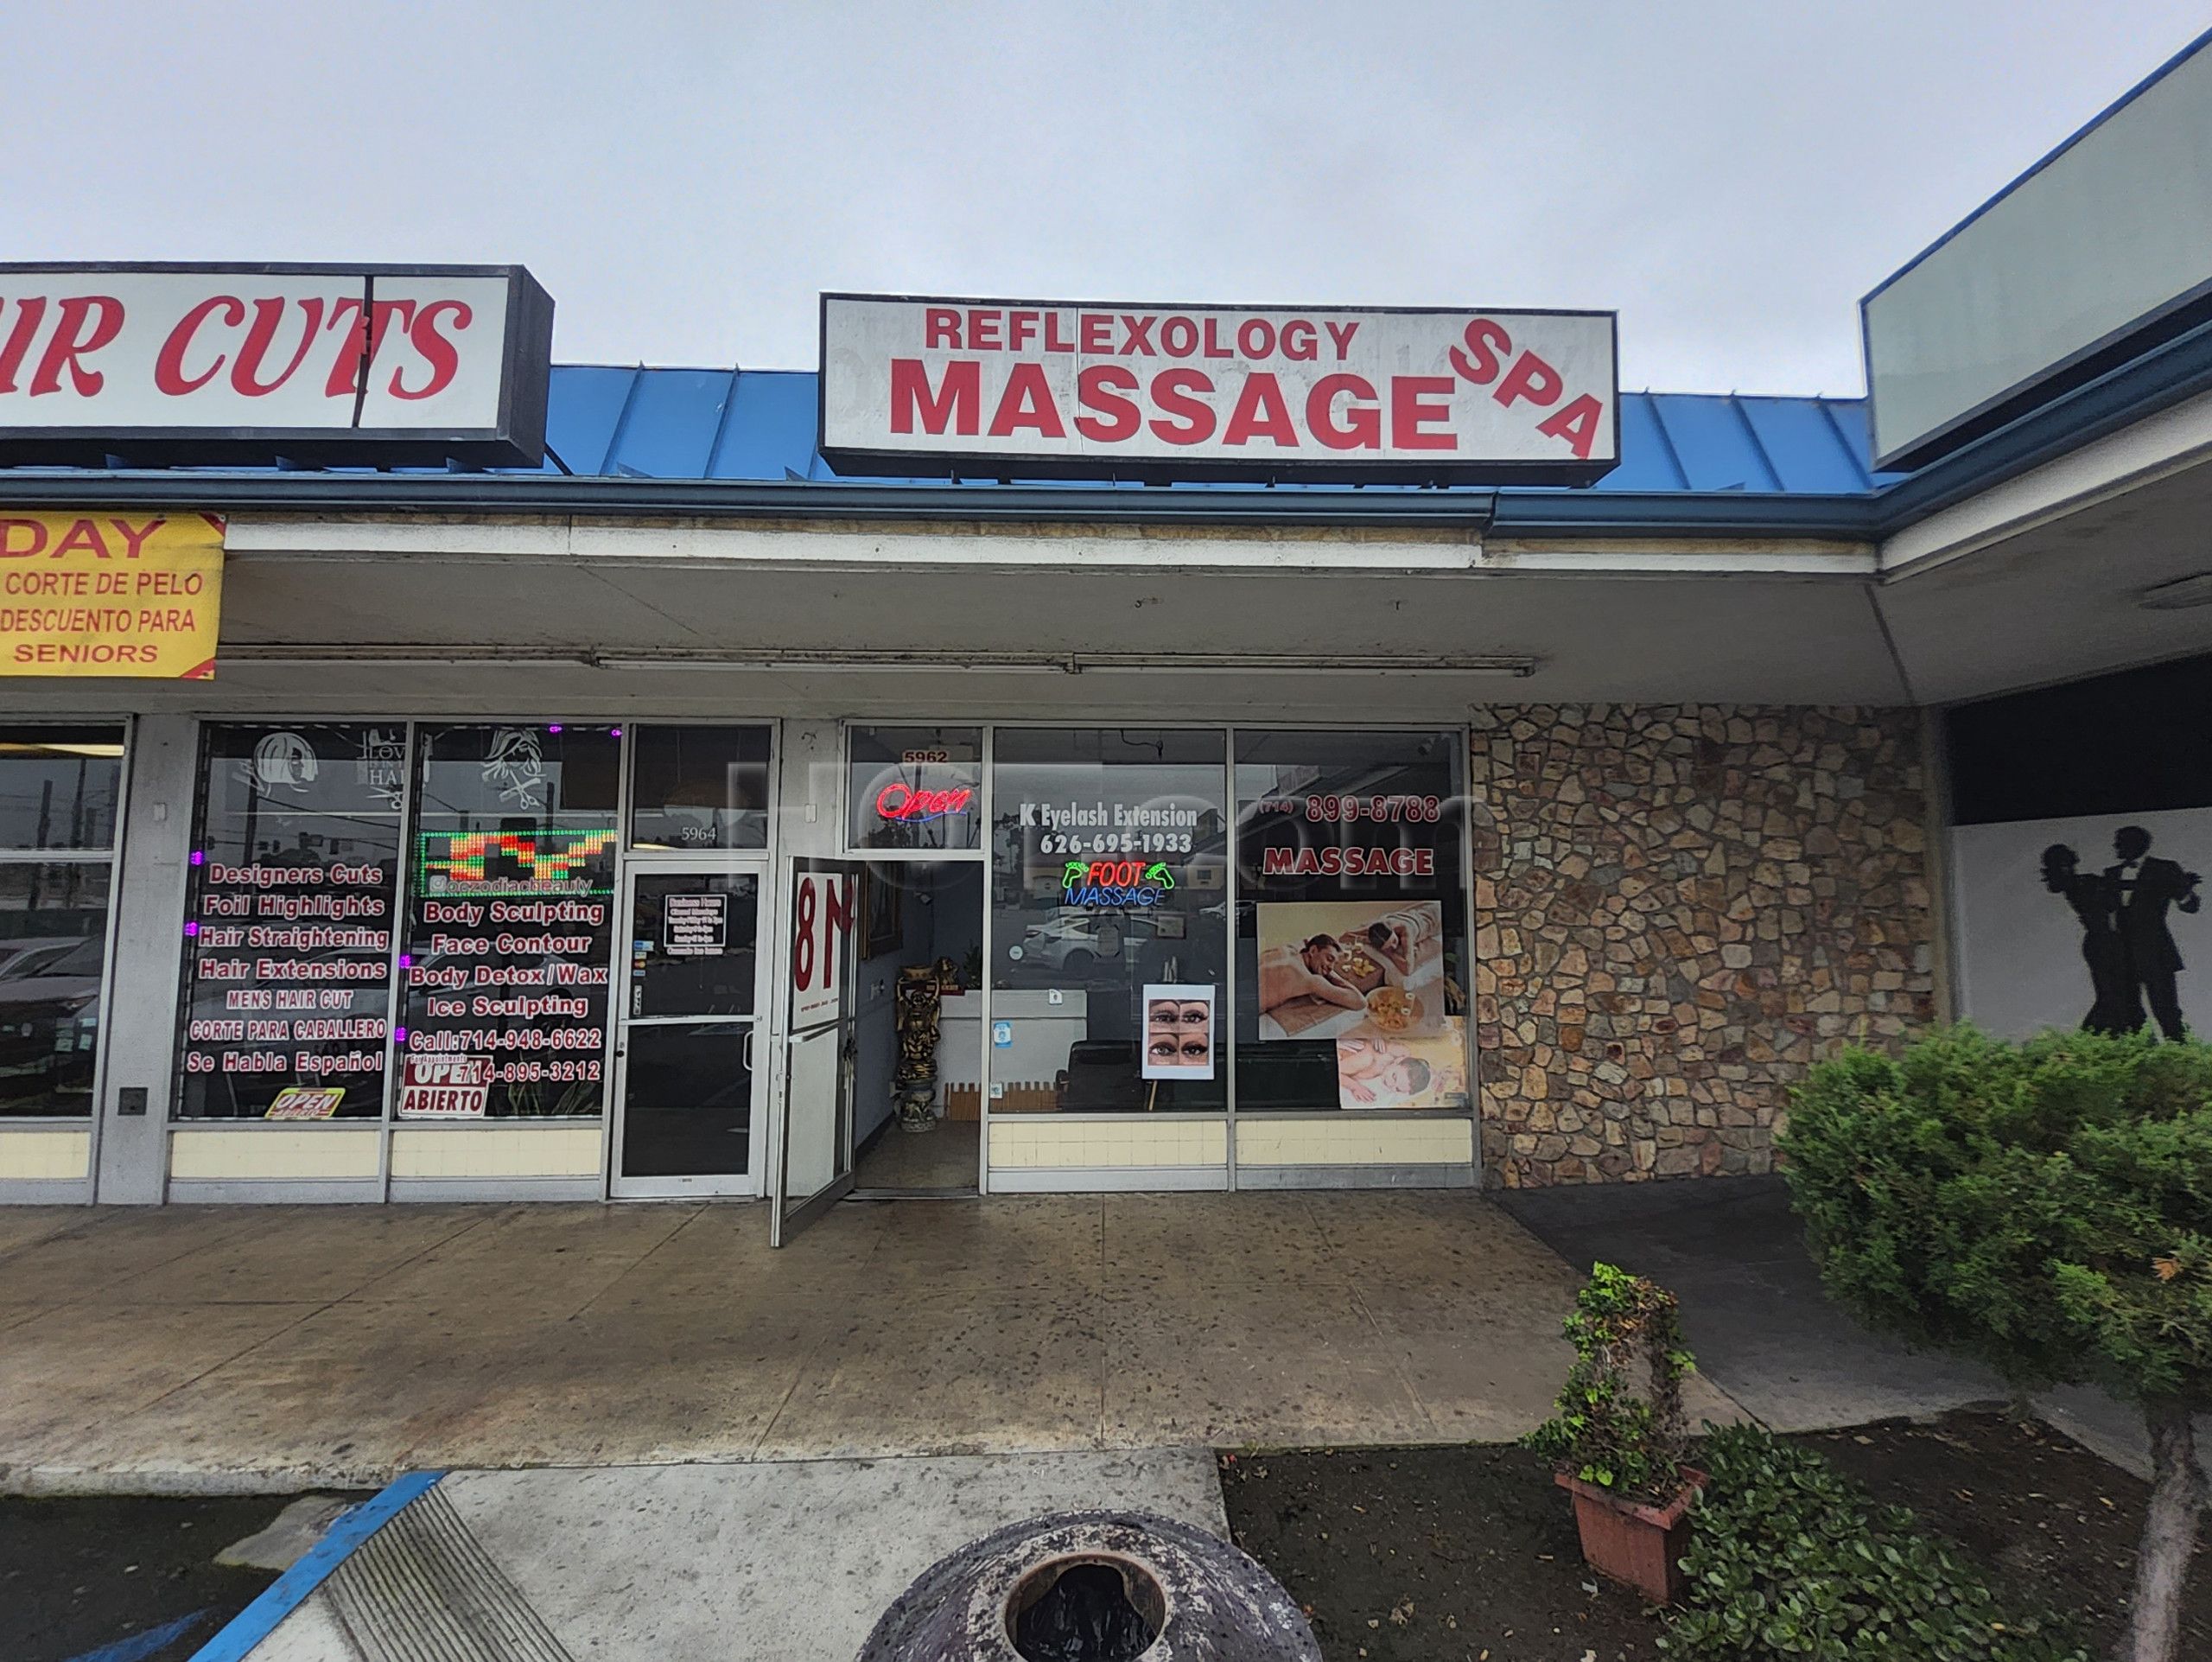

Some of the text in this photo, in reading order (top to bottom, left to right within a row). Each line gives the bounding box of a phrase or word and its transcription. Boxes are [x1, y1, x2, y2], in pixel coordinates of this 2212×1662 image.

[925, 307, 1361, 361] REFLEXOLOGY
[0, 295, 474, 401] IR CUTS
[1448, 318, 1604, 461] SPA
[890, 357, 1459, 452] MASSAGE
[0, 519, 167, 559] DAY
[5, 571, 204, 596] CORTE DE PELO
[1, 608, 196, 634] DESCUENTO PARA
[14, 644, 158, 664] SENIORS
[904, 750, 949, 763] 5962
[876, 783, 971, 820] Open
[1306, 794, 1441, 822] 899-8788
[1020, 802, 1198, 831] K Eyelash Extension
[681, 826, 717, 842] 5964
[1040, 833, 1192, 854] 626-695-1933
[1087, 861, 1147, 887] FOOT
[1262, 847, 1434, 876] MASSAGE
[208, 863, 383, 888] Designers Cuts
[203, 894, 385, 920] Foil Highlights
[1065, 887, 1166, 906] MASSAGE
[423, 901, 604, 927] Body Sculpting
[198, 926, 389, 952] Hair Straightening
[431, 933, 593, 955] Face Contour
[199, 958, 387, 980] Hair Extensions
[409, 966, 469, 990] Body
[226, 990, 354, 1009] MENS HAIR CUT
[427, 996, 588, 1019] Ice Sculpting
[189, 1018, 388, 1041] CORTE PARA CABALLERO
[187, 1050, 383, 1076] Se Habla Español
[459, 1061, 602, 1083] 714-895-3212
[276, 1093, 339, 1110] OPEN
[403, 1089, 483, 1111] ABIERTO
